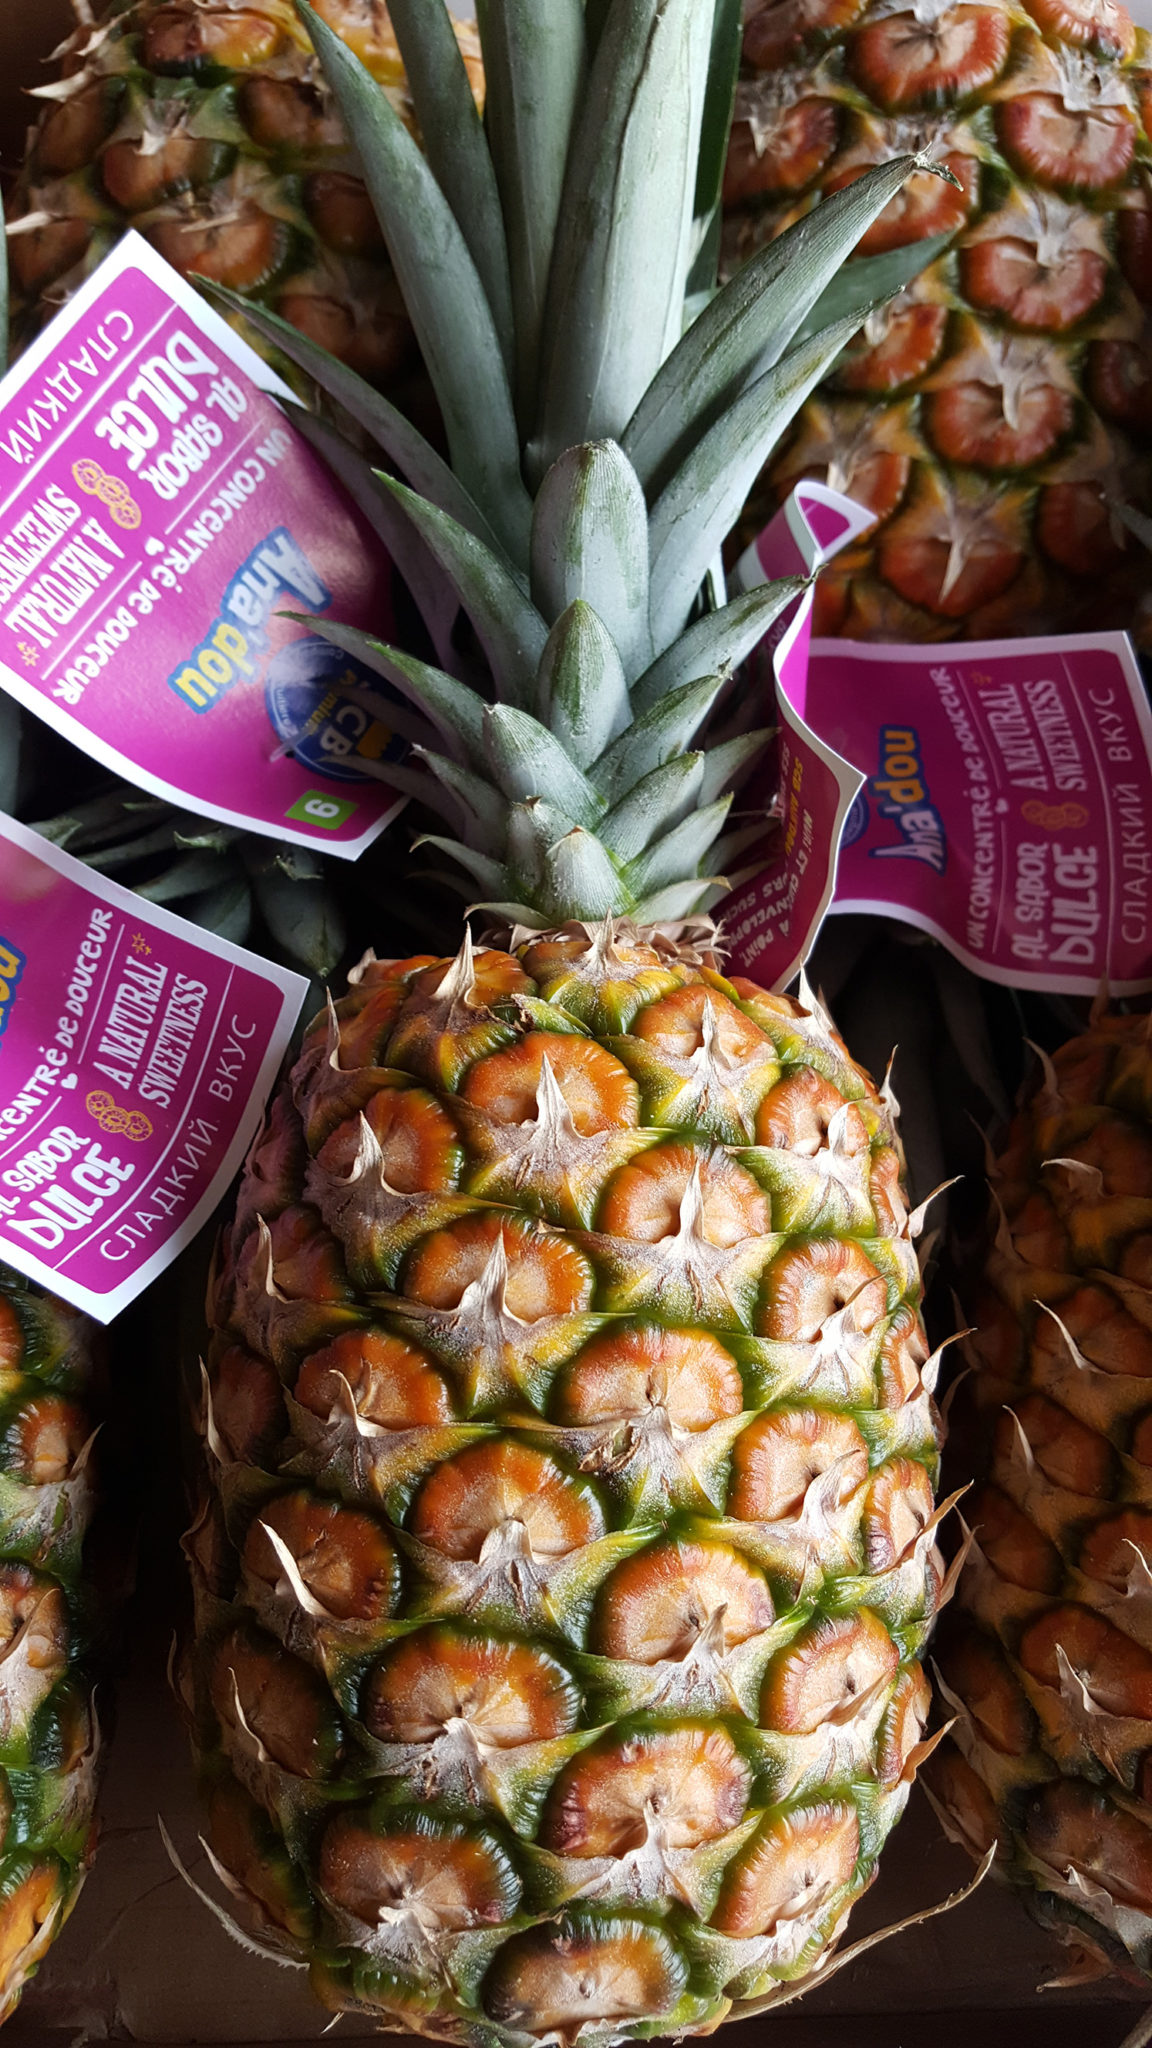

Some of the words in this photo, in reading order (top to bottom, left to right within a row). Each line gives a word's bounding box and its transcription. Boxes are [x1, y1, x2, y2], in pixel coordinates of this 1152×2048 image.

[0, 310, 134, 465] СЛАДКИЙ
[94, 329, 220, 472] DULCE
[205, 376, 247, 423] AL
[138, 413, 224, 500] SABOR
[255, 428, 293, 467] UN
[81, 517, 126, 559] A
[4, 534, 115, 649] NATURAL
[174, 533, 327, 707] Ana'dou
[52, 605, 139, 706] DOUCEUR
[929, 665, 980, 753] DOUCEUR
[978, 683, 1046, 773] NATURAL
[1022, 679, 1088, 791] SWEETNESS
[1088, 688, 1133, 762] ВКУС
[873, 729, 944, 870] Ana'dou
[1010, 775, 1050, 792] A
[1014, 841, 1050, 923] SABOR
[1049, 842, 1102, 965] DULCE
[1111, 783, 1151, 944] СЛАДКИЙ
[65, 907, 114, 1018] DOUCEUR
[967, 921, 989, 949] UN
[1010, 933, 1050, 960] AL
[98, 955, 169, 1070] NATURAL
[138, 971, 209, 1110] SWEETNESS
[93, 1061, 135, 1091] A
[2, 1125, 92, 1193] SABOR
[100, 1117, 219, 1261] СЛАДКИЙ
[208, 1013, 257, 1103] ВКУС
[6, 1142, 136, 1250] DULCE
